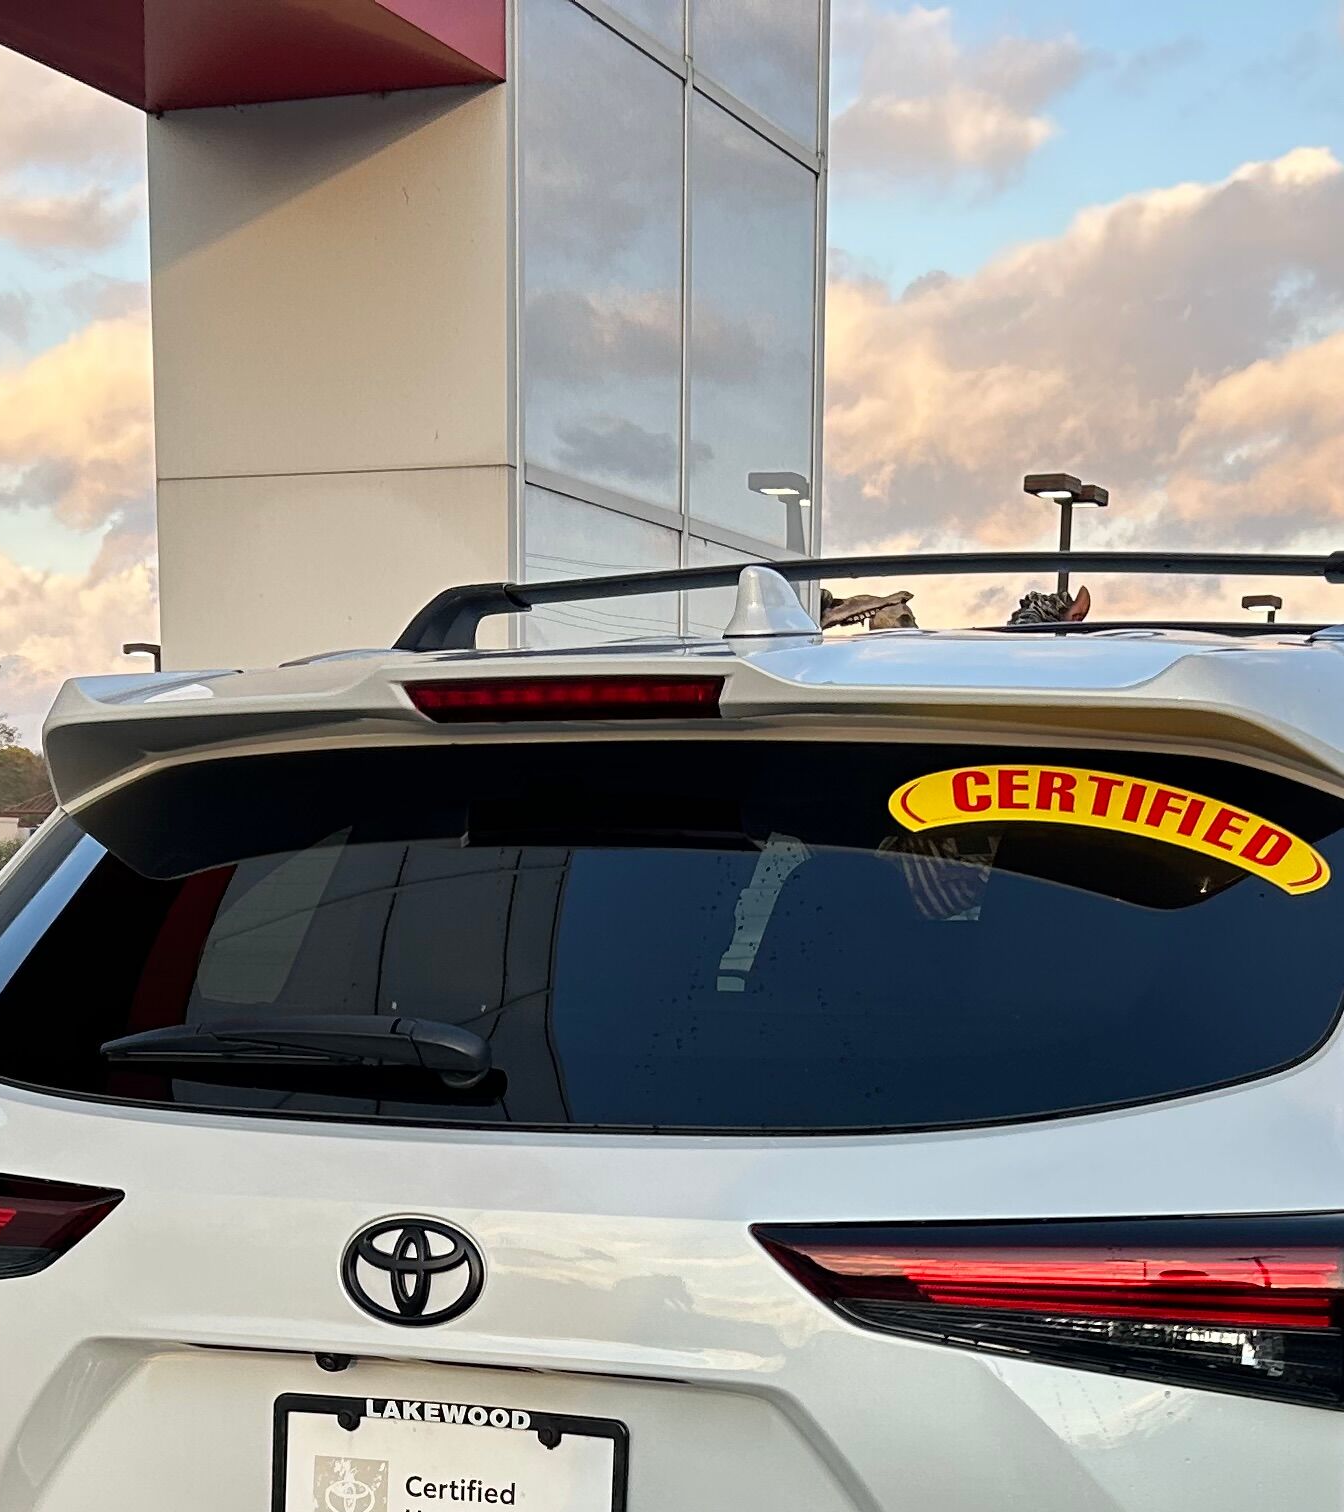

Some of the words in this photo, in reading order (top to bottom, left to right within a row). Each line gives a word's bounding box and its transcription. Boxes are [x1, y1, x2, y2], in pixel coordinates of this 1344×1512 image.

[951, 769, 1294, 867] CERTIFIED
[365, 1398, 532, 1431] LAKEWOOD
[405, 1475, 516, 1506] Certified
